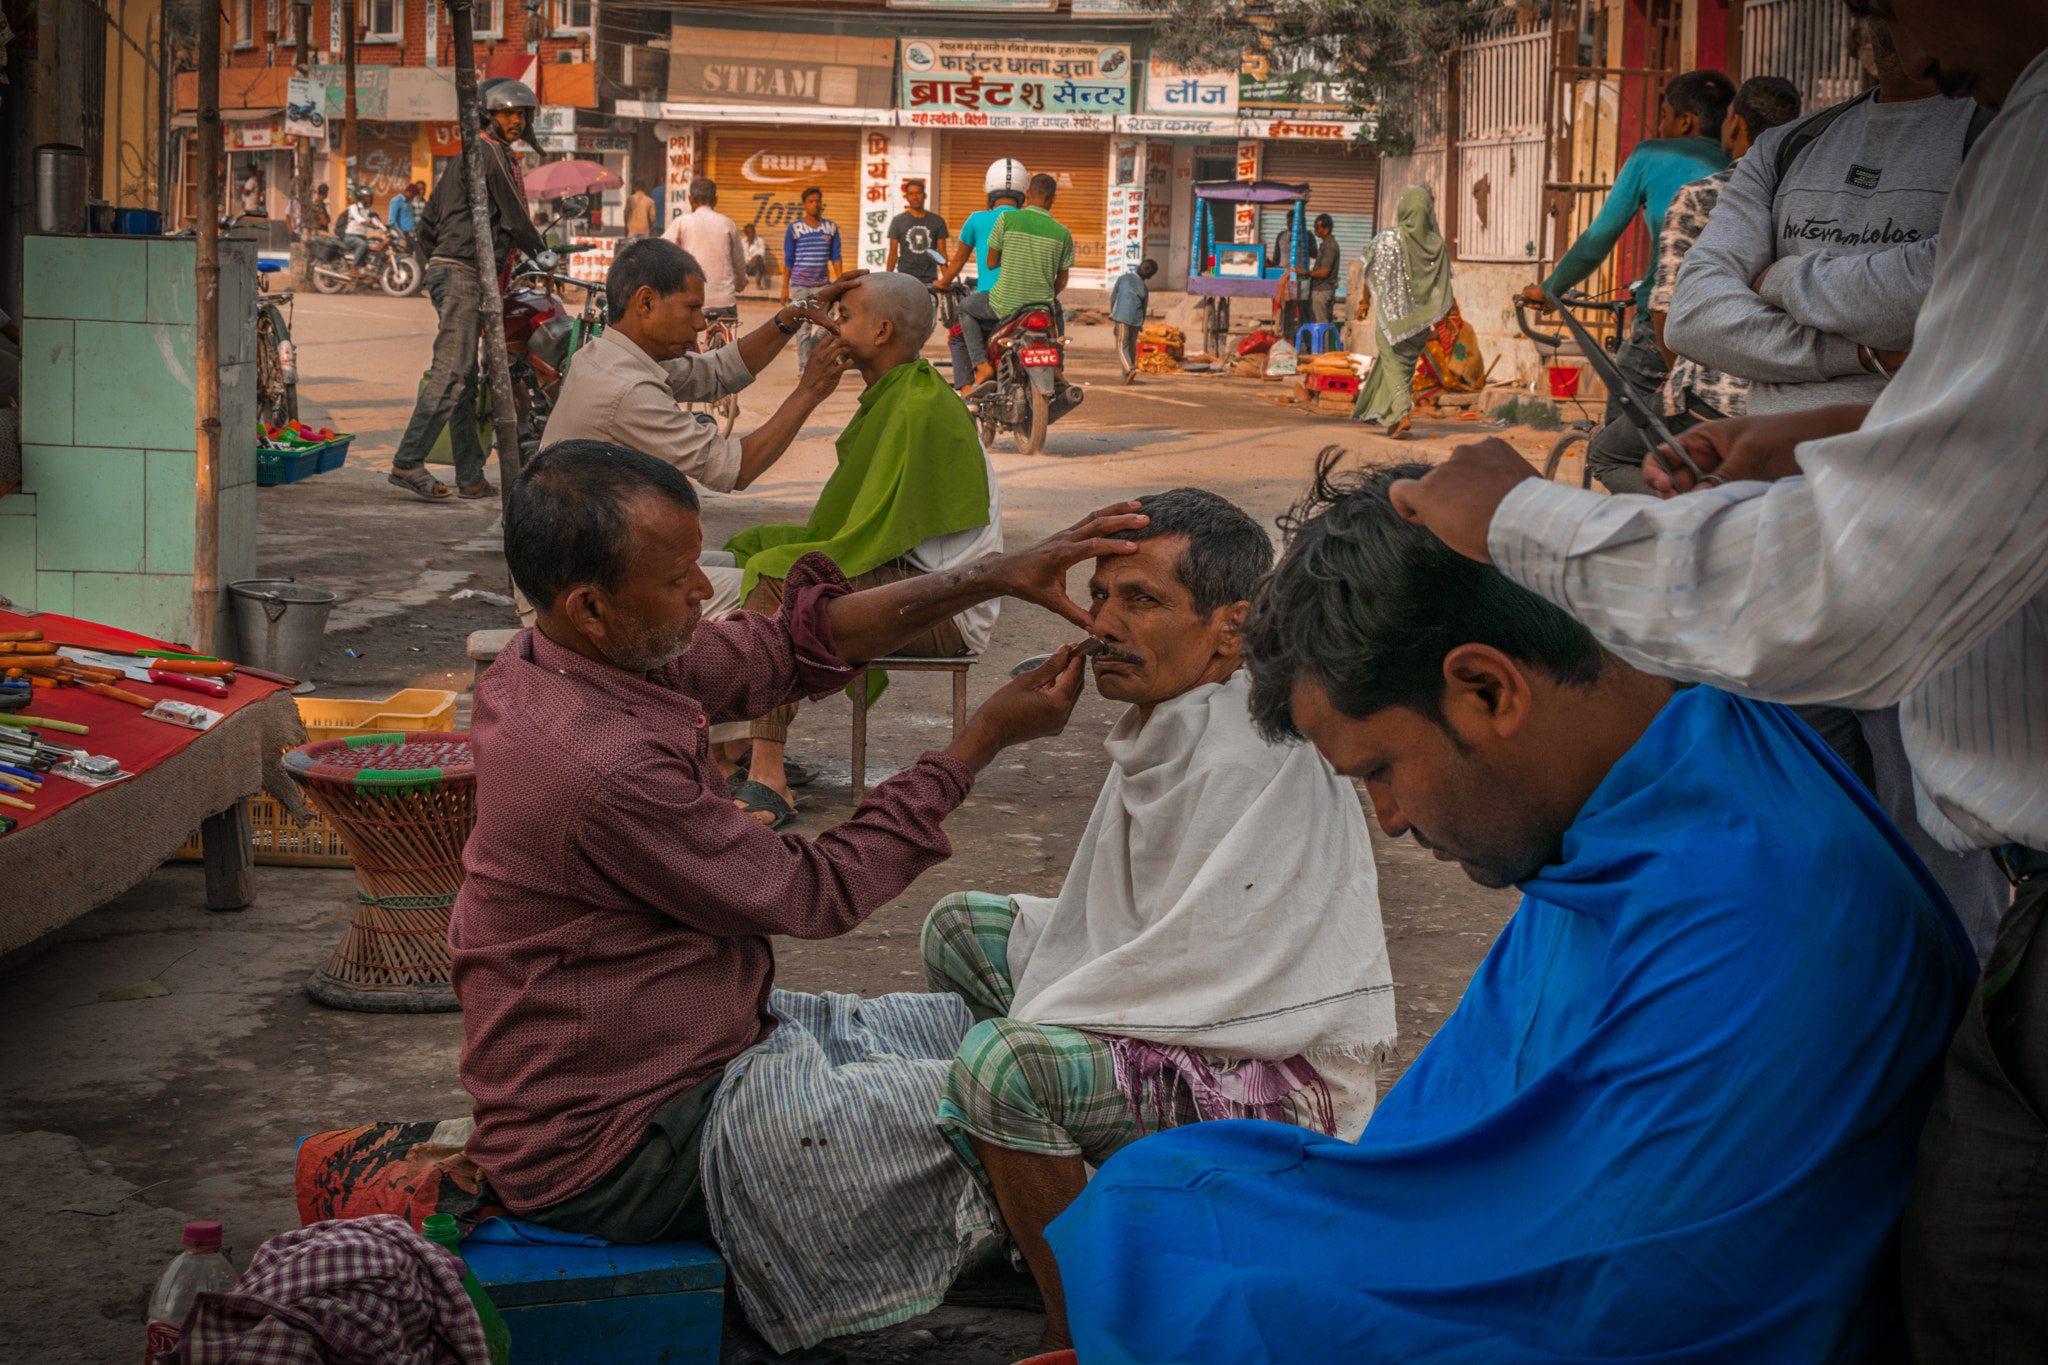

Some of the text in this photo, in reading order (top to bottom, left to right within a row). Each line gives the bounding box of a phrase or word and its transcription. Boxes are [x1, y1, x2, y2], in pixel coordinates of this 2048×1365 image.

[1007, 57, 1051, 75] छाला
[702, 64, 817, 98] STEAM
[1165, 79, 1228, 104] लॉज
[910, 77, 1126, 111] ब्राईट शु सेन्टर
[761, 153, 829, 172] RUPA
